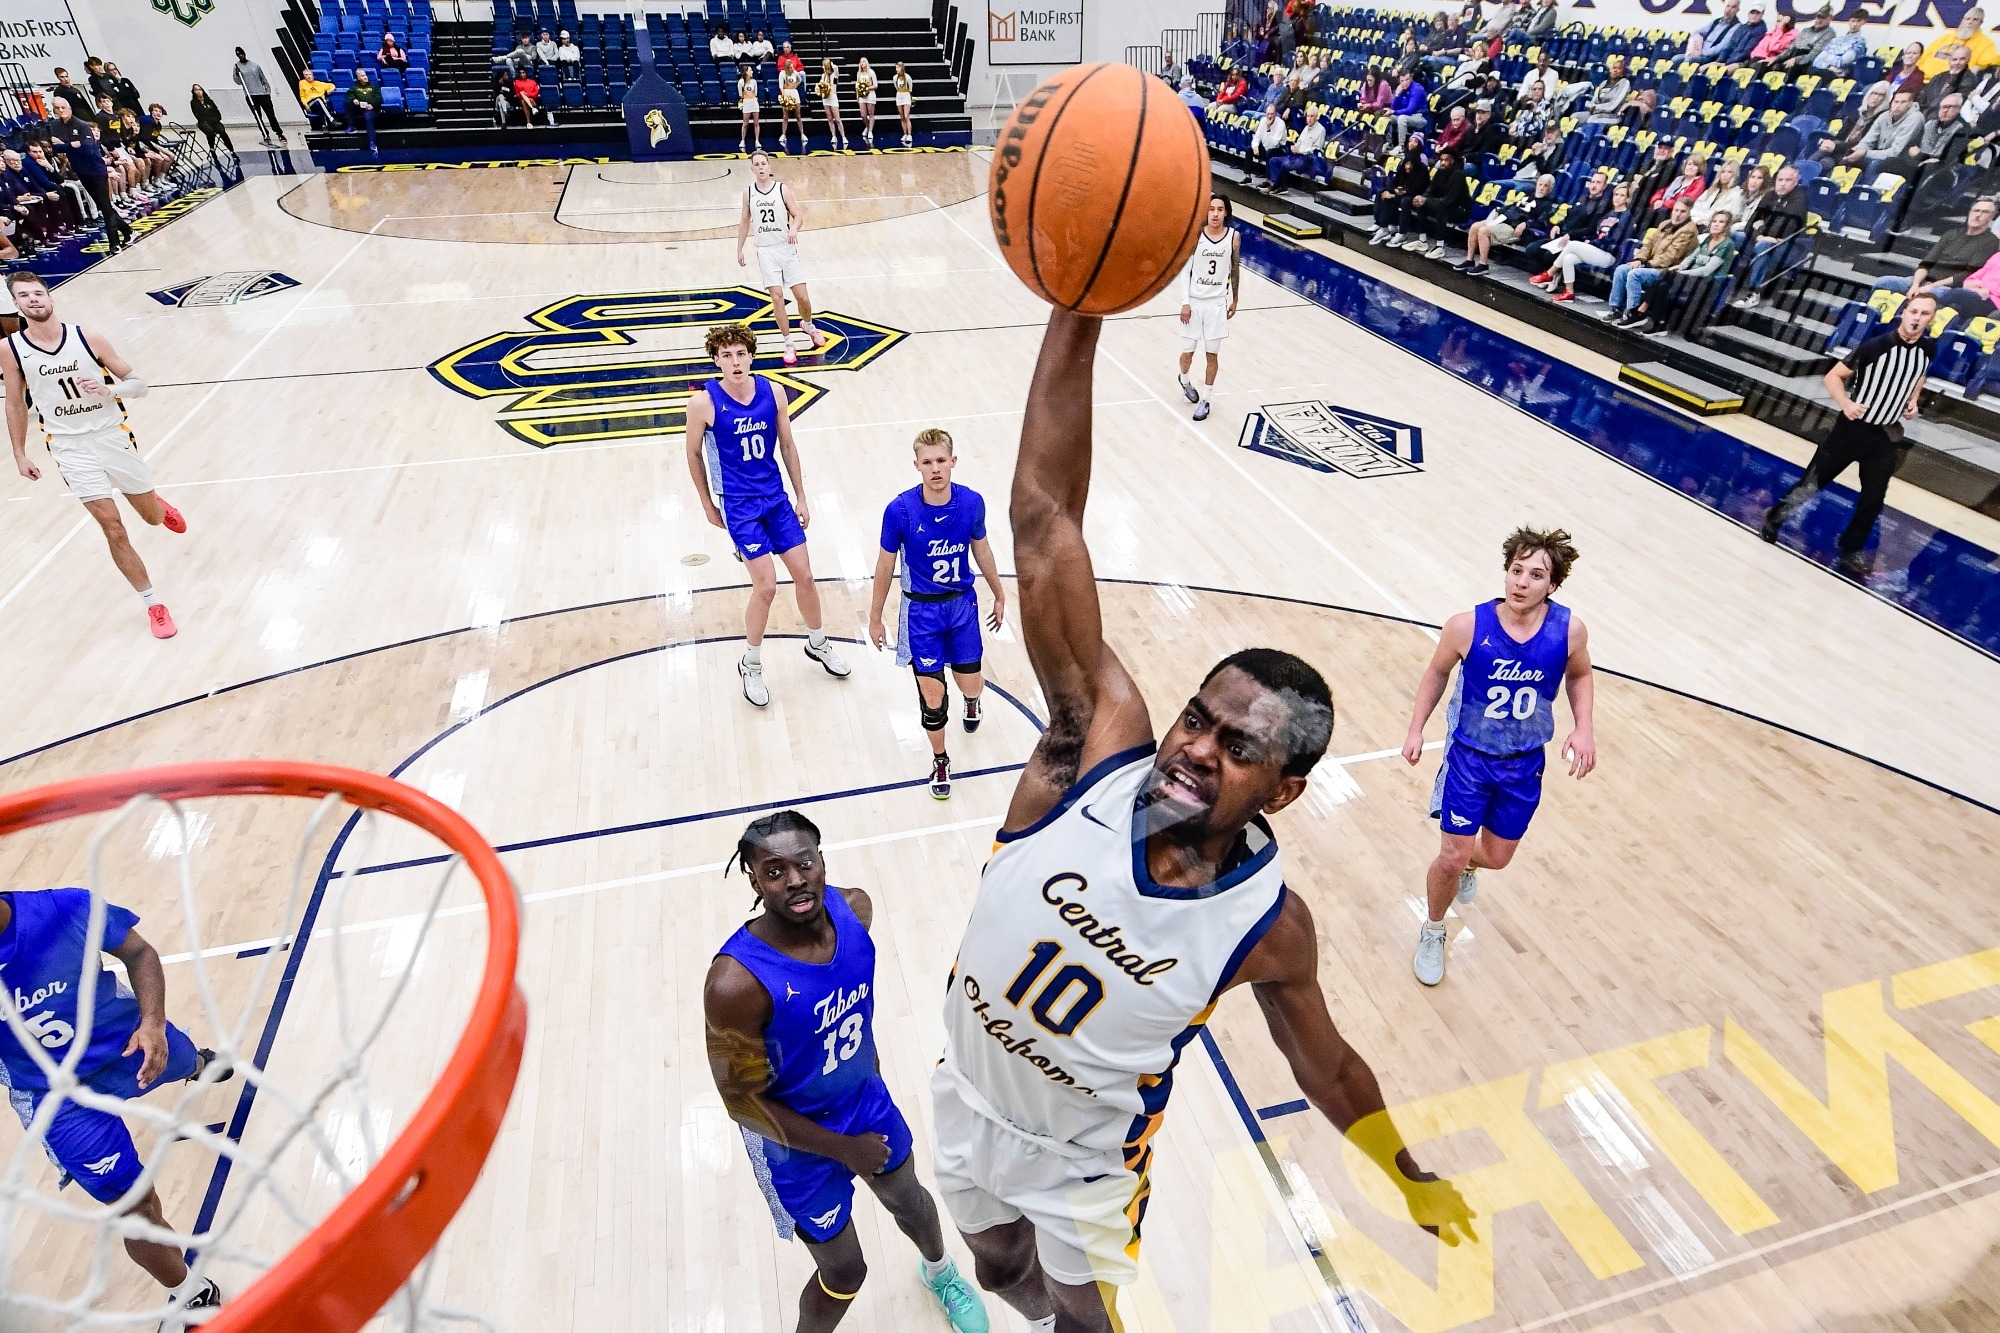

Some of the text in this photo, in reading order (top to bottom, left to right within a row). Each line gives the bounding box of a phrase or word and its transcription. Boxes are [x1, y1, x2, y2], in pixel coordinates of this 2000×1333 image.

[1020, 27, 1056, 41] BANK
[336, 156, 633, 173] CENTRAL
[756, 199, 775, 208] Central
[759, 209, 775, 223] 23
[1201, 248, 1226, 258] Central
[1208, 260, 1217, 275] 3
[38, 359, 79, 376] Central
[57, 376, 82, 400] 11
[54, 402, 103, 417] Oklahoma
[733, 417, 768, 435] Tabor
[740, 434, 766, 462] 10
[926, 539, 965, 557] Tabor
[932, 557, 961, 584] 21
[1487, 658, 1545, 682] Tabor
[1483, 685, 1538, 721] 20
[1042, 872, 1178, 986] Central
[1003, 939, 1107, 1038] 10
[814, 982, 869, 1035] Tabor
[822, 1012, 864, 1076] 13
